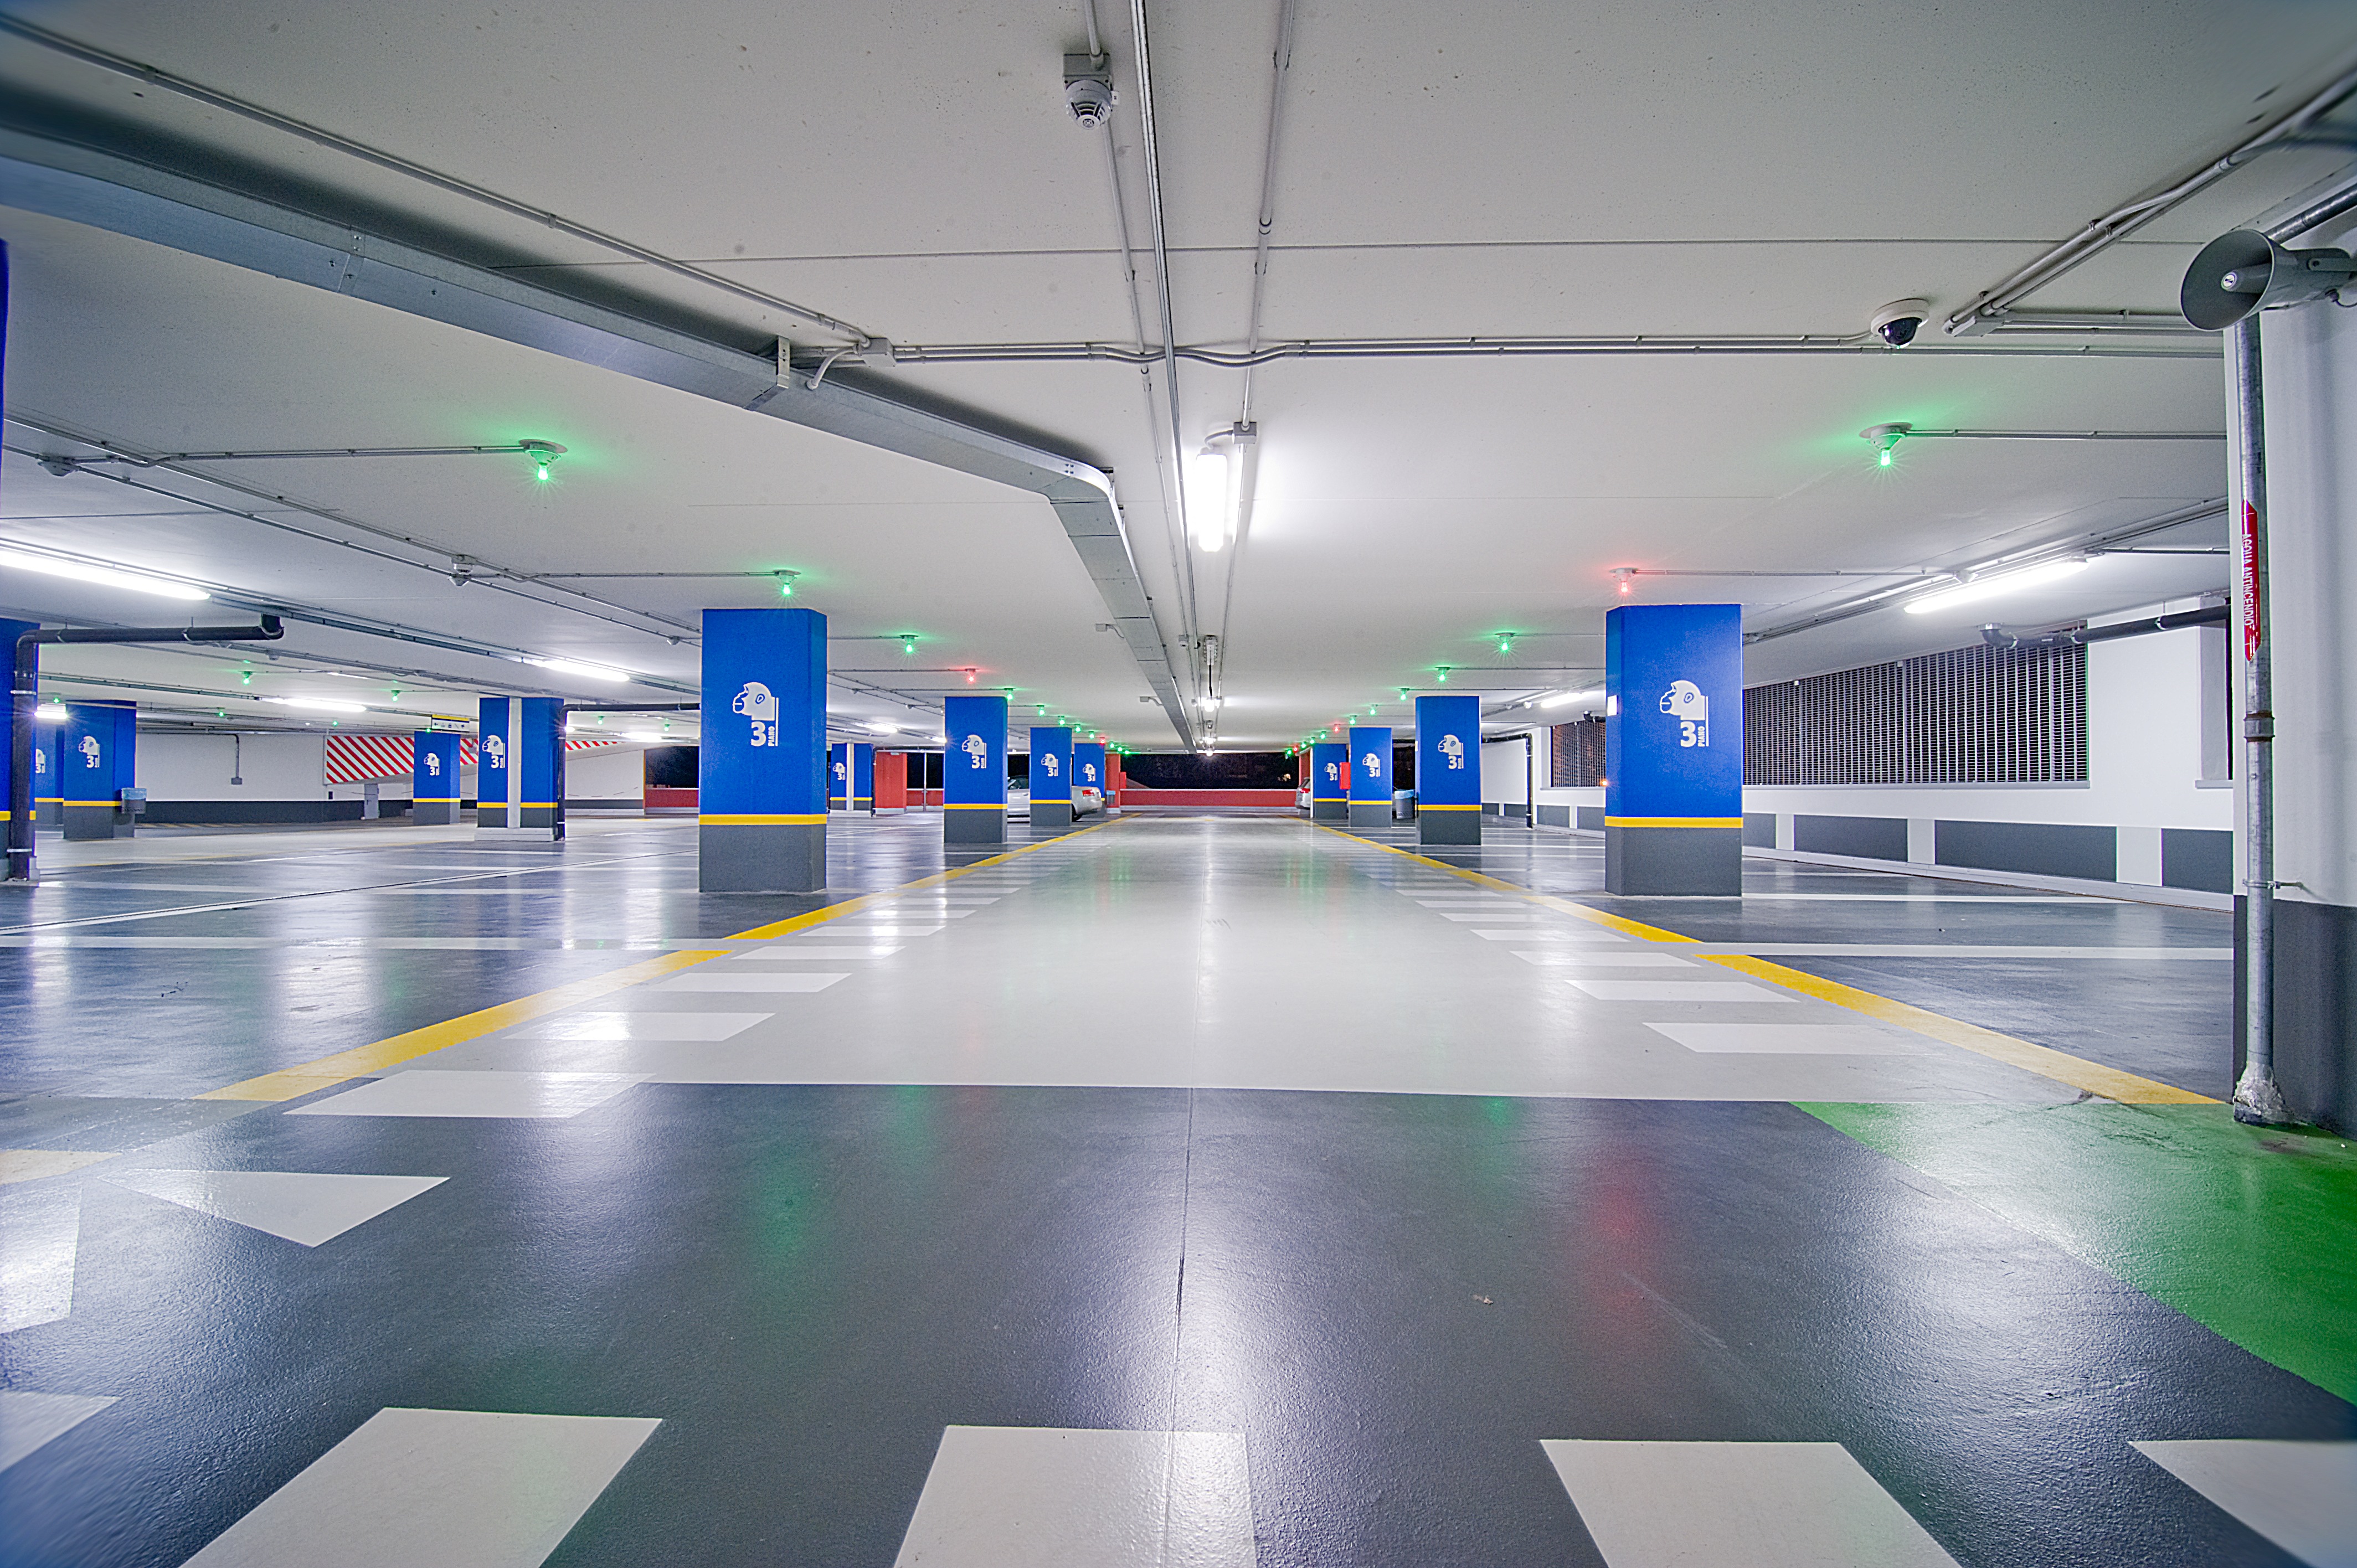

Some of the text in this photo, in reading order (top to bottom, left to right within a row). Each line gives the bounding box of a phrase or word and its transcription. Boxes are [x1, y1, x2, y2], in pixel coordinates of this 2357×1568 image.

[2242, 534, 2254, 626] ACQUA ANTINCENDIO
[751, 721, 766, 747] 3
[1680, 721, 1697, 747] 3
[86, 755, 95, 768] 3
[491, 755, 499, 768] 3
[971, 755, 980, 769] 3
[1448, 755, 1457, 769] 3
[35, 764, 42, 773] 3
[430, 766, 436, 776] 3
[1048, 767, 1054, 776] 3
[1369, 767, 1376, 777] 3
